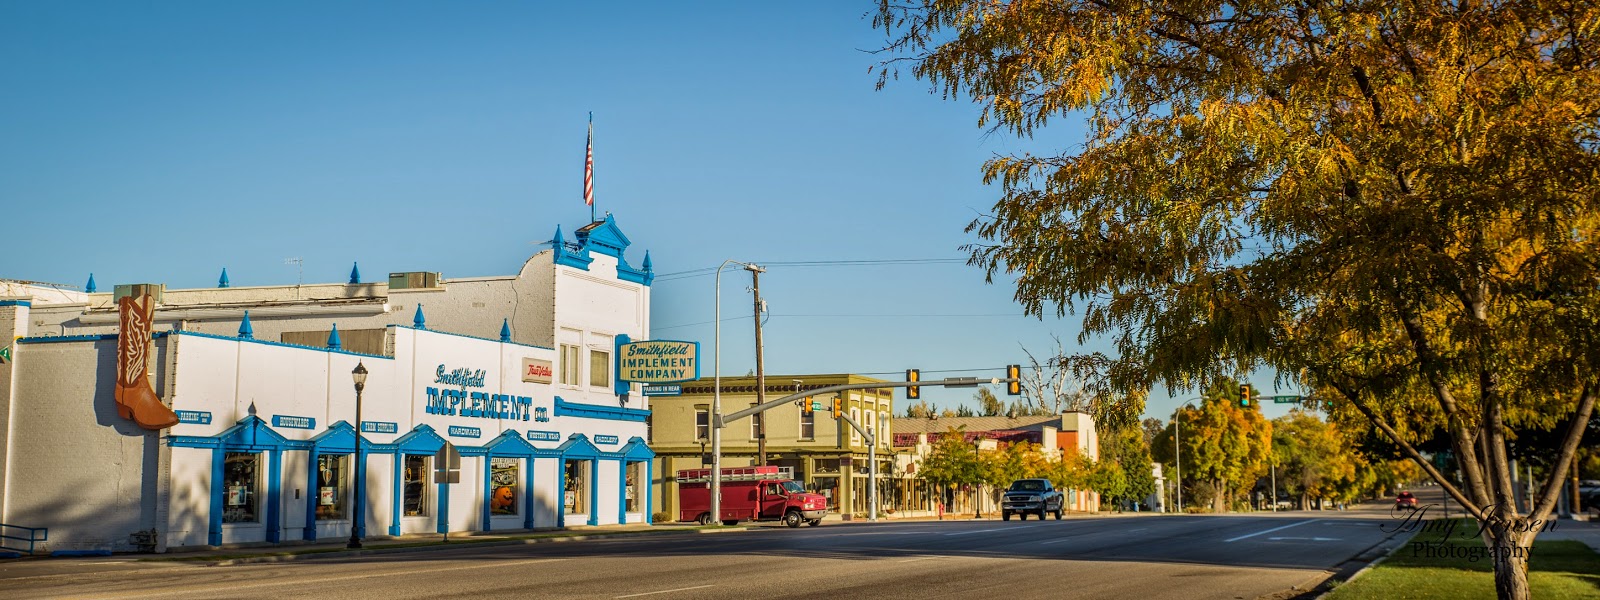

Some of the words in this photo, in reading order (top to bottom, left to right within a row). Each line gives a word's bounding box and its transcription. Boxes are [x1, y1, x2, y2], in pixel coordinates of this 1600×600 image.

[627, 344, 689, 358] Smithfield
[622, 358, 693, 367] IMPLEMENT
[433, 364, 487, 391] Smithfield
[630, 369, 685, 379] COMPANY
[425, 386, 533, 421] IMPLEMENT
[180, 412, 199, 421] PARKING
[279, 416, 309, 428] HOUSEWARES
[450, 427, 480, 436] HARDWARE
